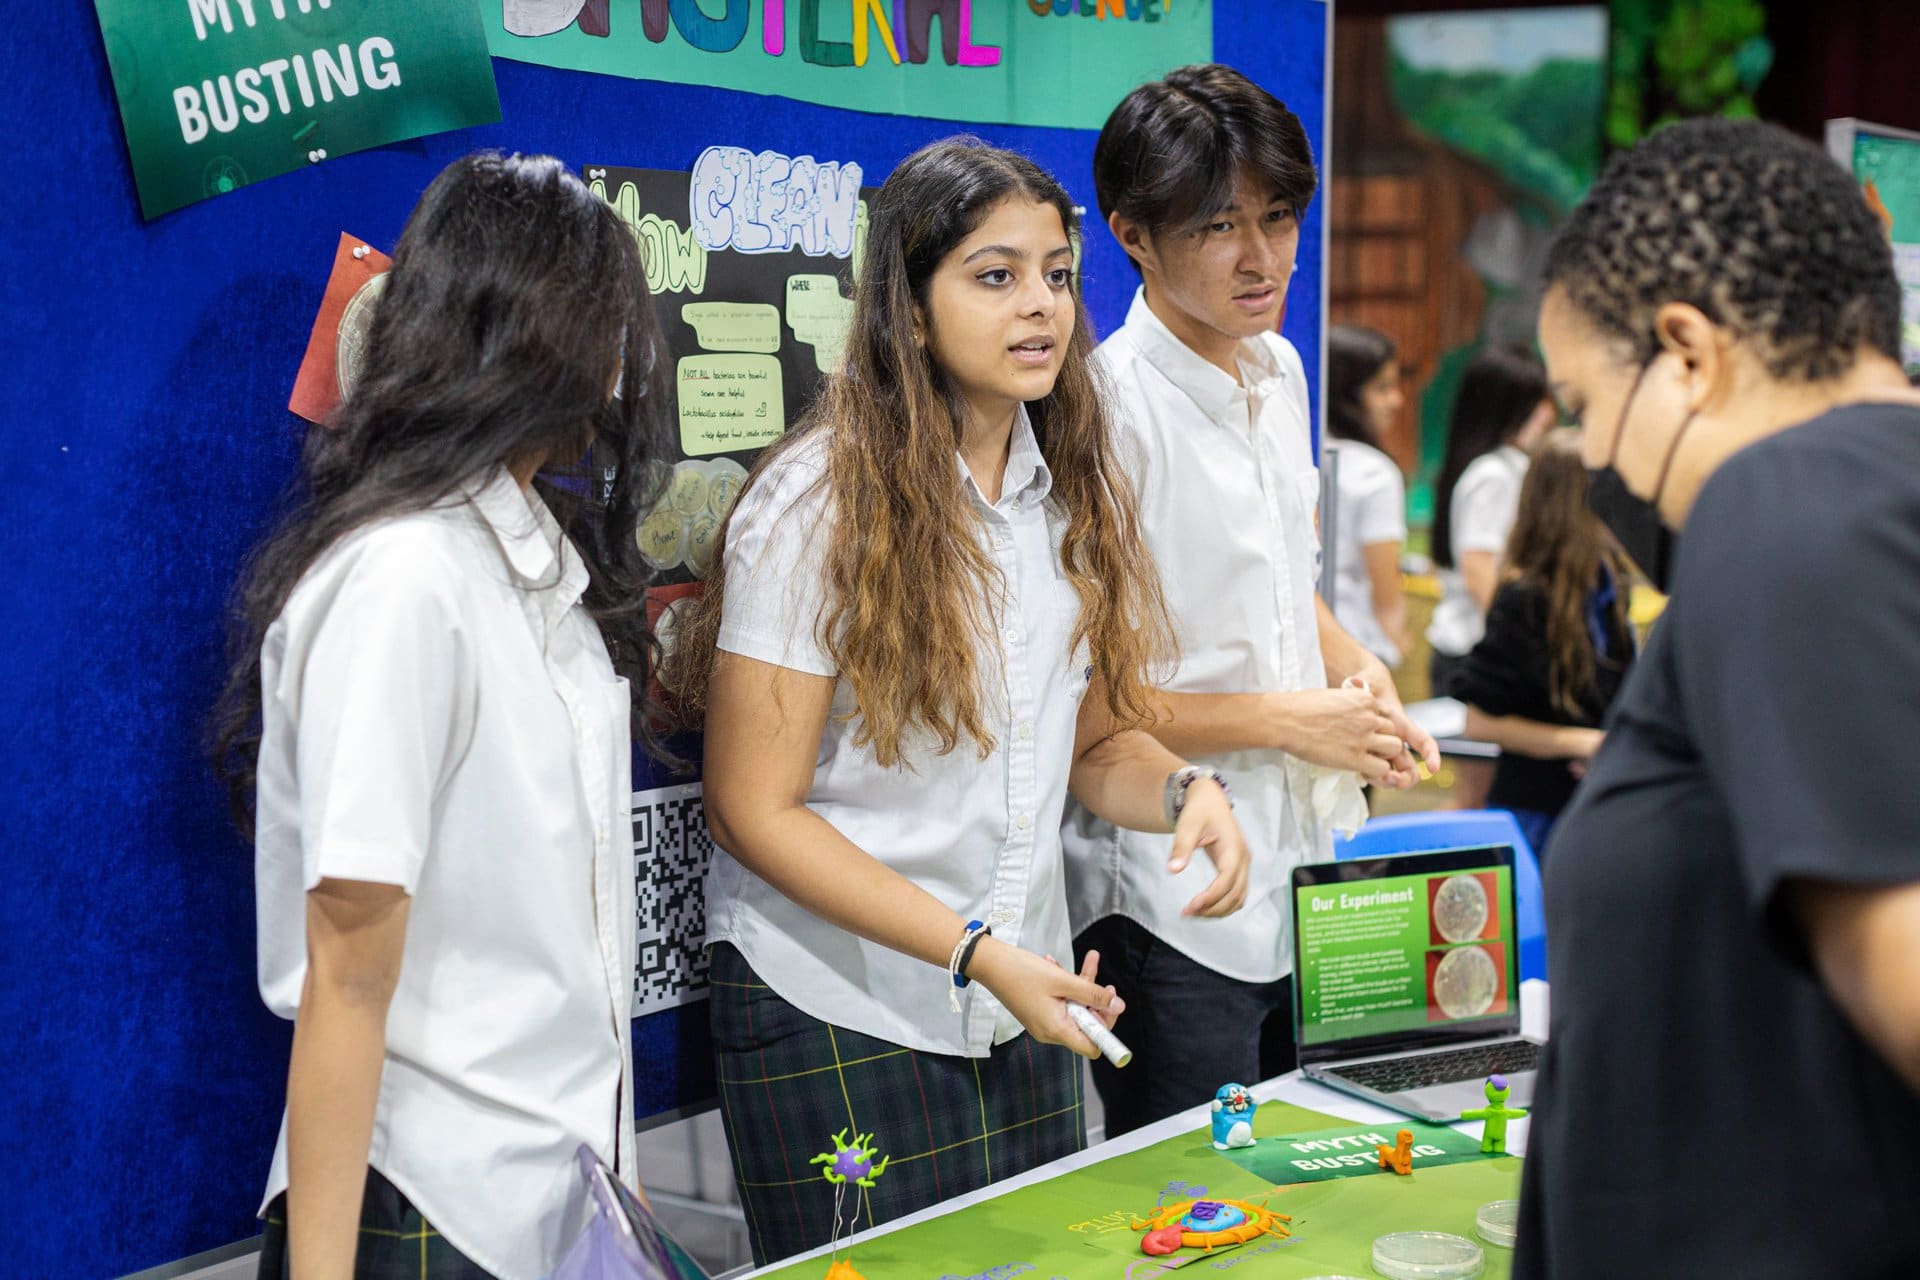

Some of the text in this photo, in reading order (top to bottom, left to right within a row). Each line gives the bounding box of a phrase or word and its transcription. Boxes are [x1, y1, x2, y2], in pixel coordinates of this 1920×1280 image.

[188, 0, 331, 41] MY
[173, 37, 401, 144] BUSTING
[695, 147, 861, 255] CLEAN
[683, 368, 697, 378] NOT
[1312, 887, 1413, 913] Our Experiment
[1290, 1132, 1389, 1153] MYTH
[1290, 1144, 1446, 1171] BUSTG
